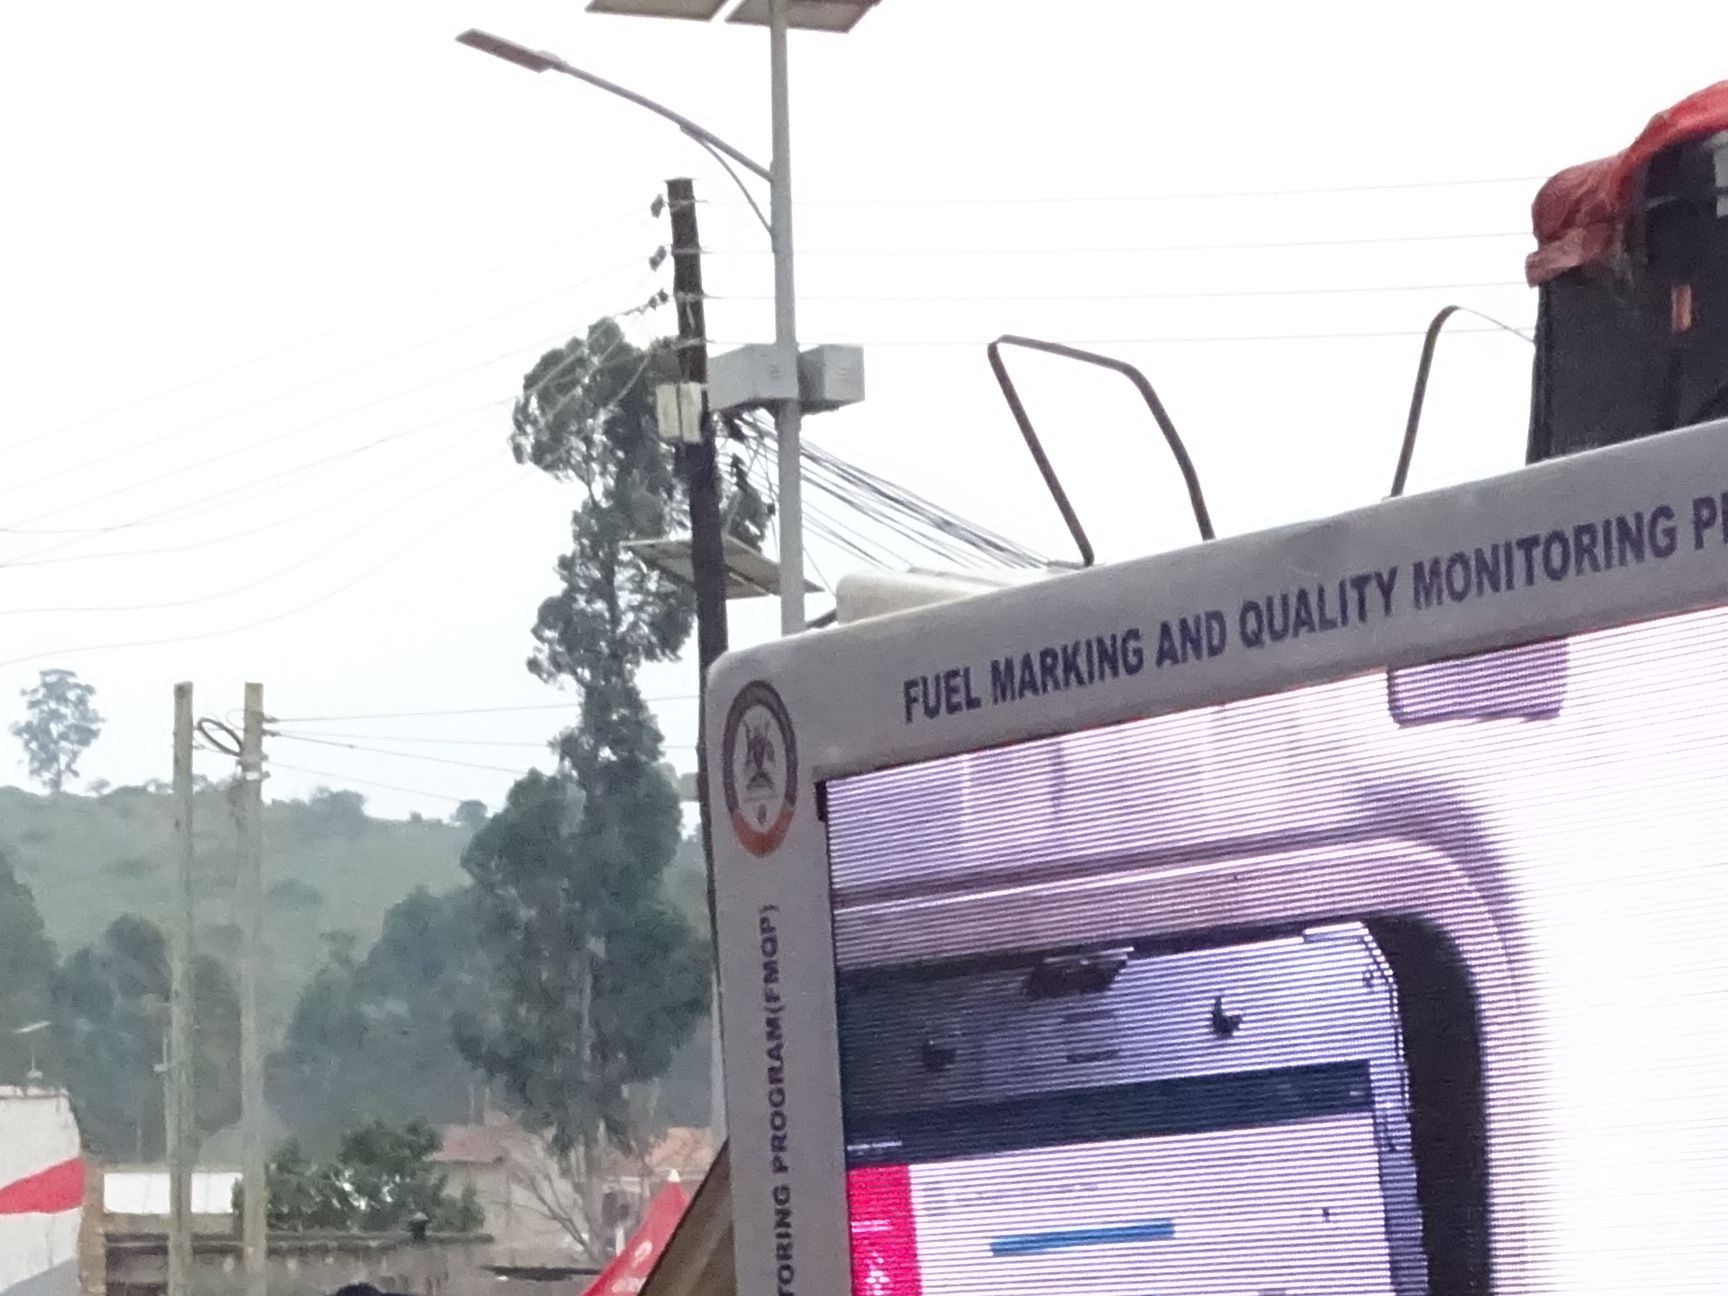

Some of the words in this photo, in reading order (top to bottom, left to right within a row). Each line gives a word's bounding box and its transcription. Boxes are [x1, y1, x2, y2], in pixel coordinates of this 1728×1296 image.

[903, 666, 981, 724] FUEL
[989, 627, 1145, 705] MARKING
[1155, 610, 1227, 669] AND
[1238, 567, 1397, 649] QUALITY
[1411, 505, 1678, 611] MONITORING
